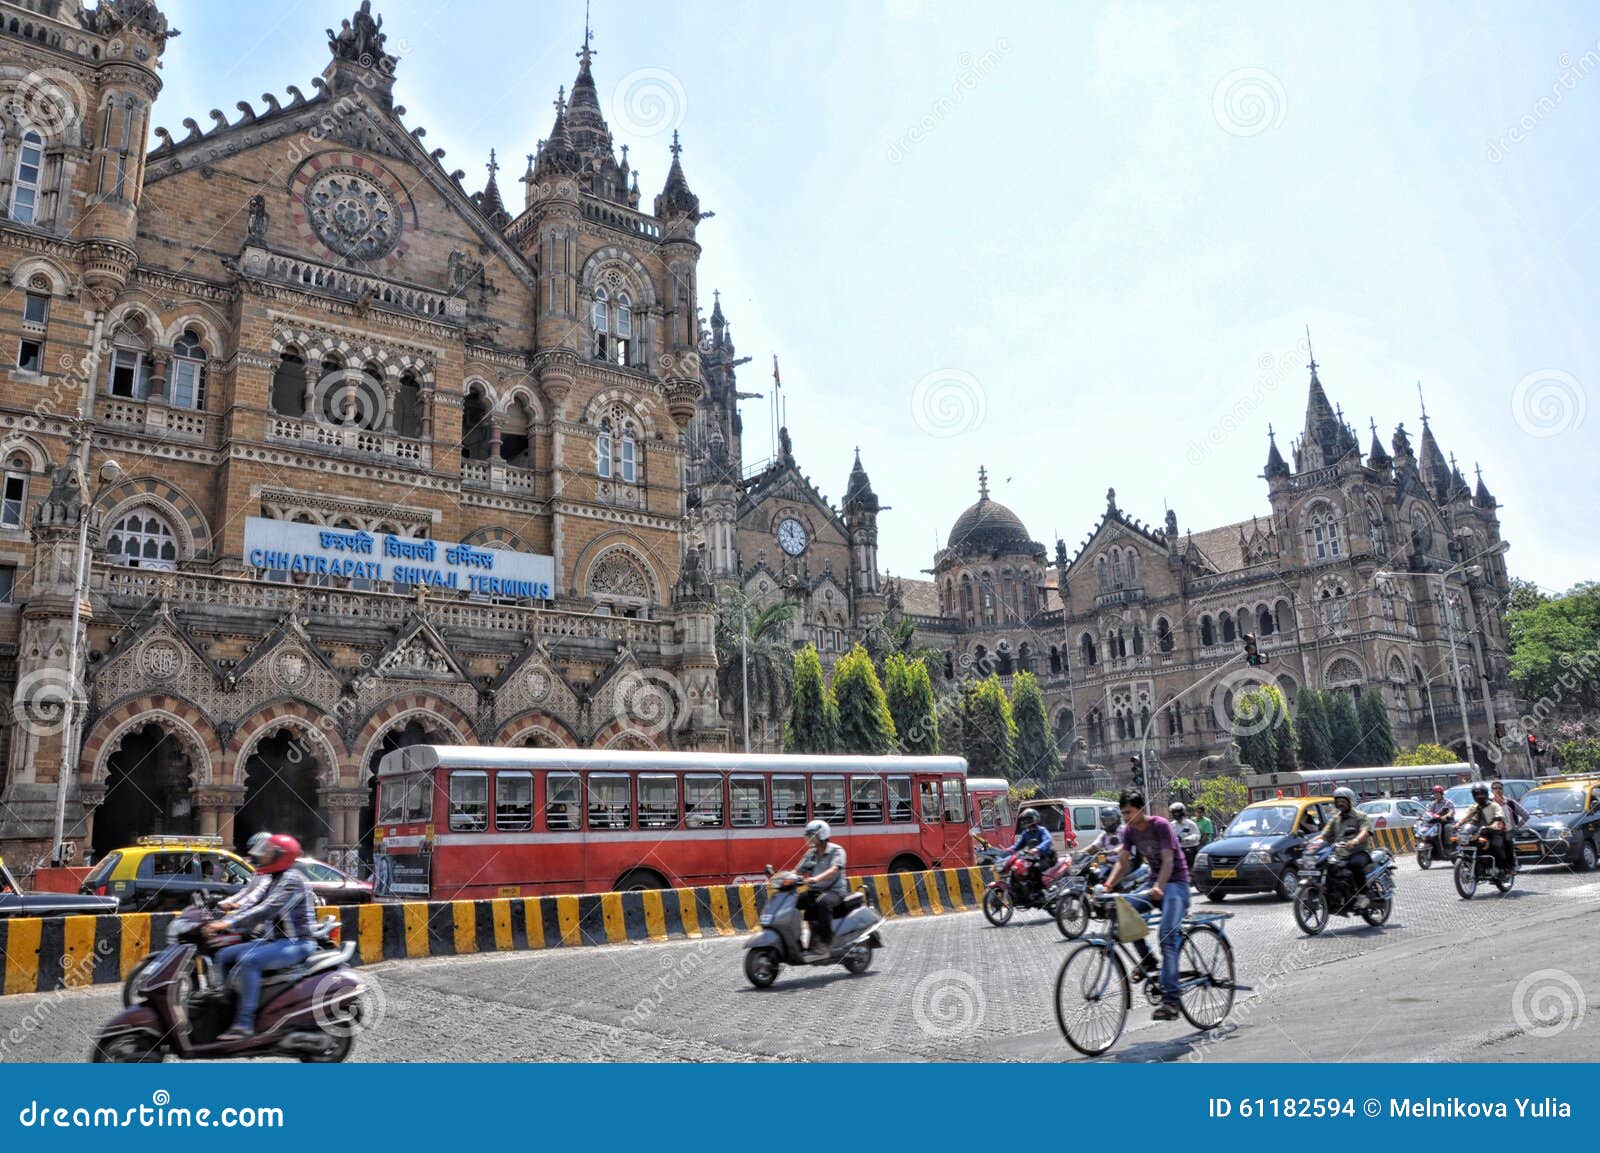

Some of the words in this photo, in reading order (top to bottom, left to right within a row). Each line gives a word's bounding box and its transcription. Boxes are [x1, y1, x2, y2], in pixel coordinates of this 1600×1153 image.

[320, 530, 375, 554] छत्रपति
[384, 534, 436, 562] शिवाजी
[446, 543, 494, 569] टर्मिनस
[251, 548, 382, 580] CHHATRAPATI
[393, 565, 458, 589] SHIVAJI
[468, 574, 549, 598] TERMINUS
